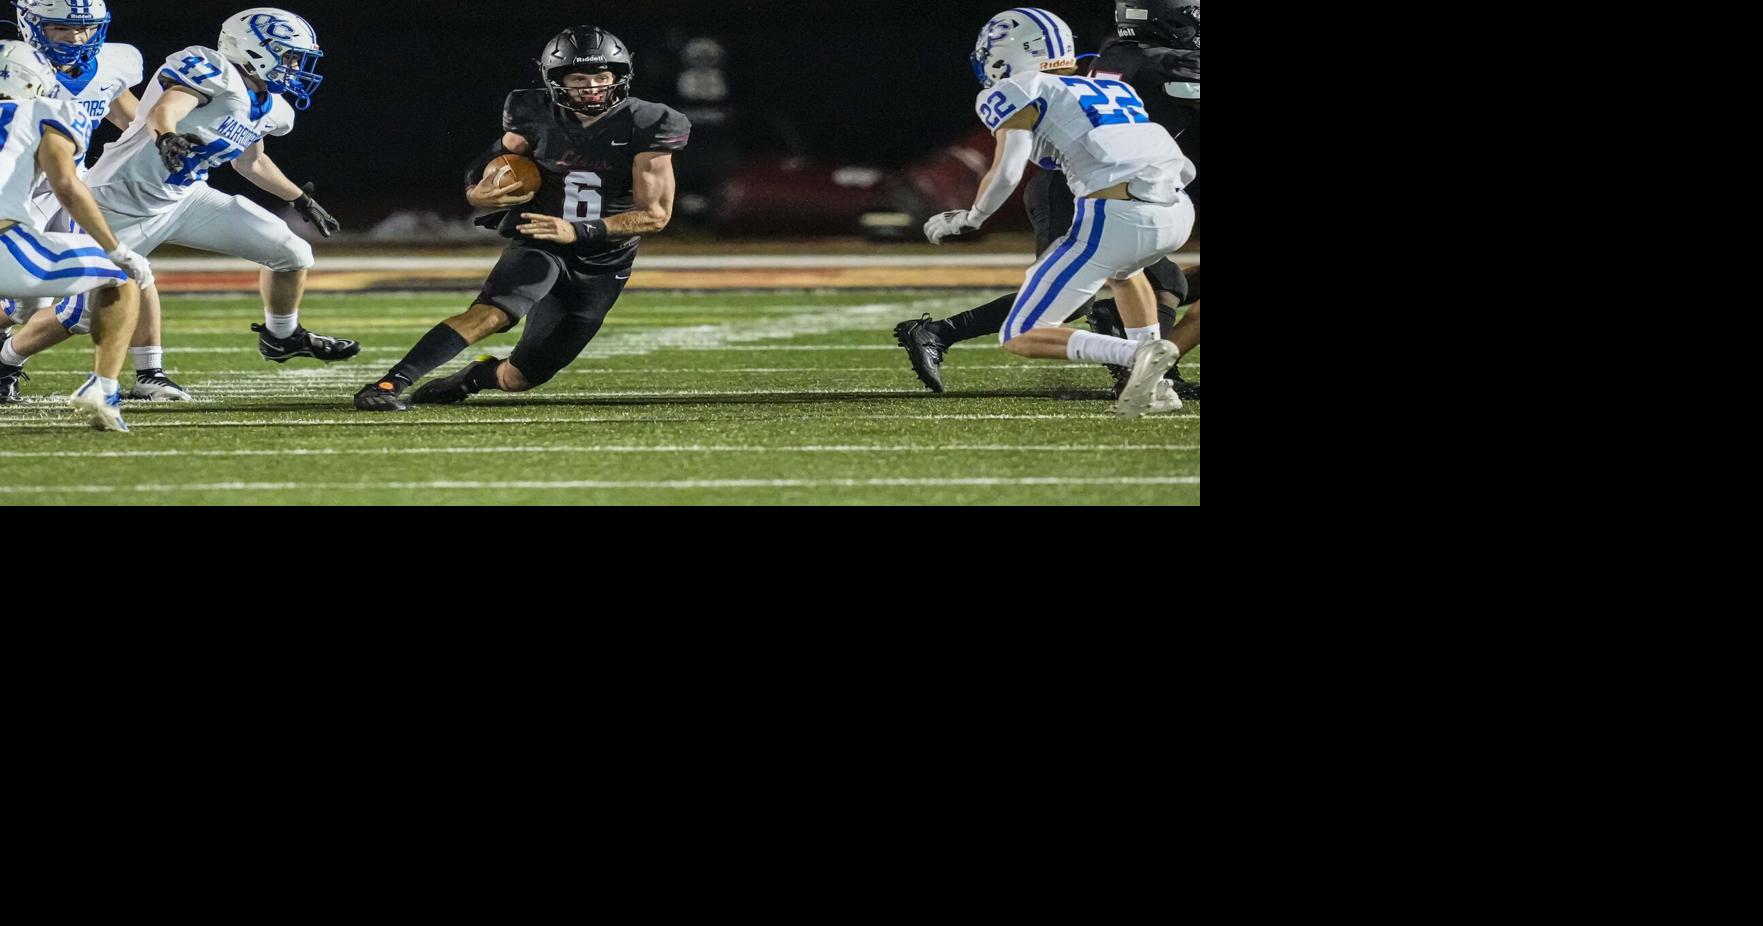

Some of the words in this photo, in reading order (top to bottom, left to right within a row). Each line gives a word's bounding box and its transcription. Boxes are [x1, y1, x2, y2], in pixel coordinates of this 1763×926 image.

[178, 56, 222, 84] 47
[576, 55, 604, 63] Riddell
[1039, 58, 1075, 69] Riddell
[980, 90, 1016, 128] 22
[1060, 77, 1149, 128] 22
[563, 171, 601, 222] 6
